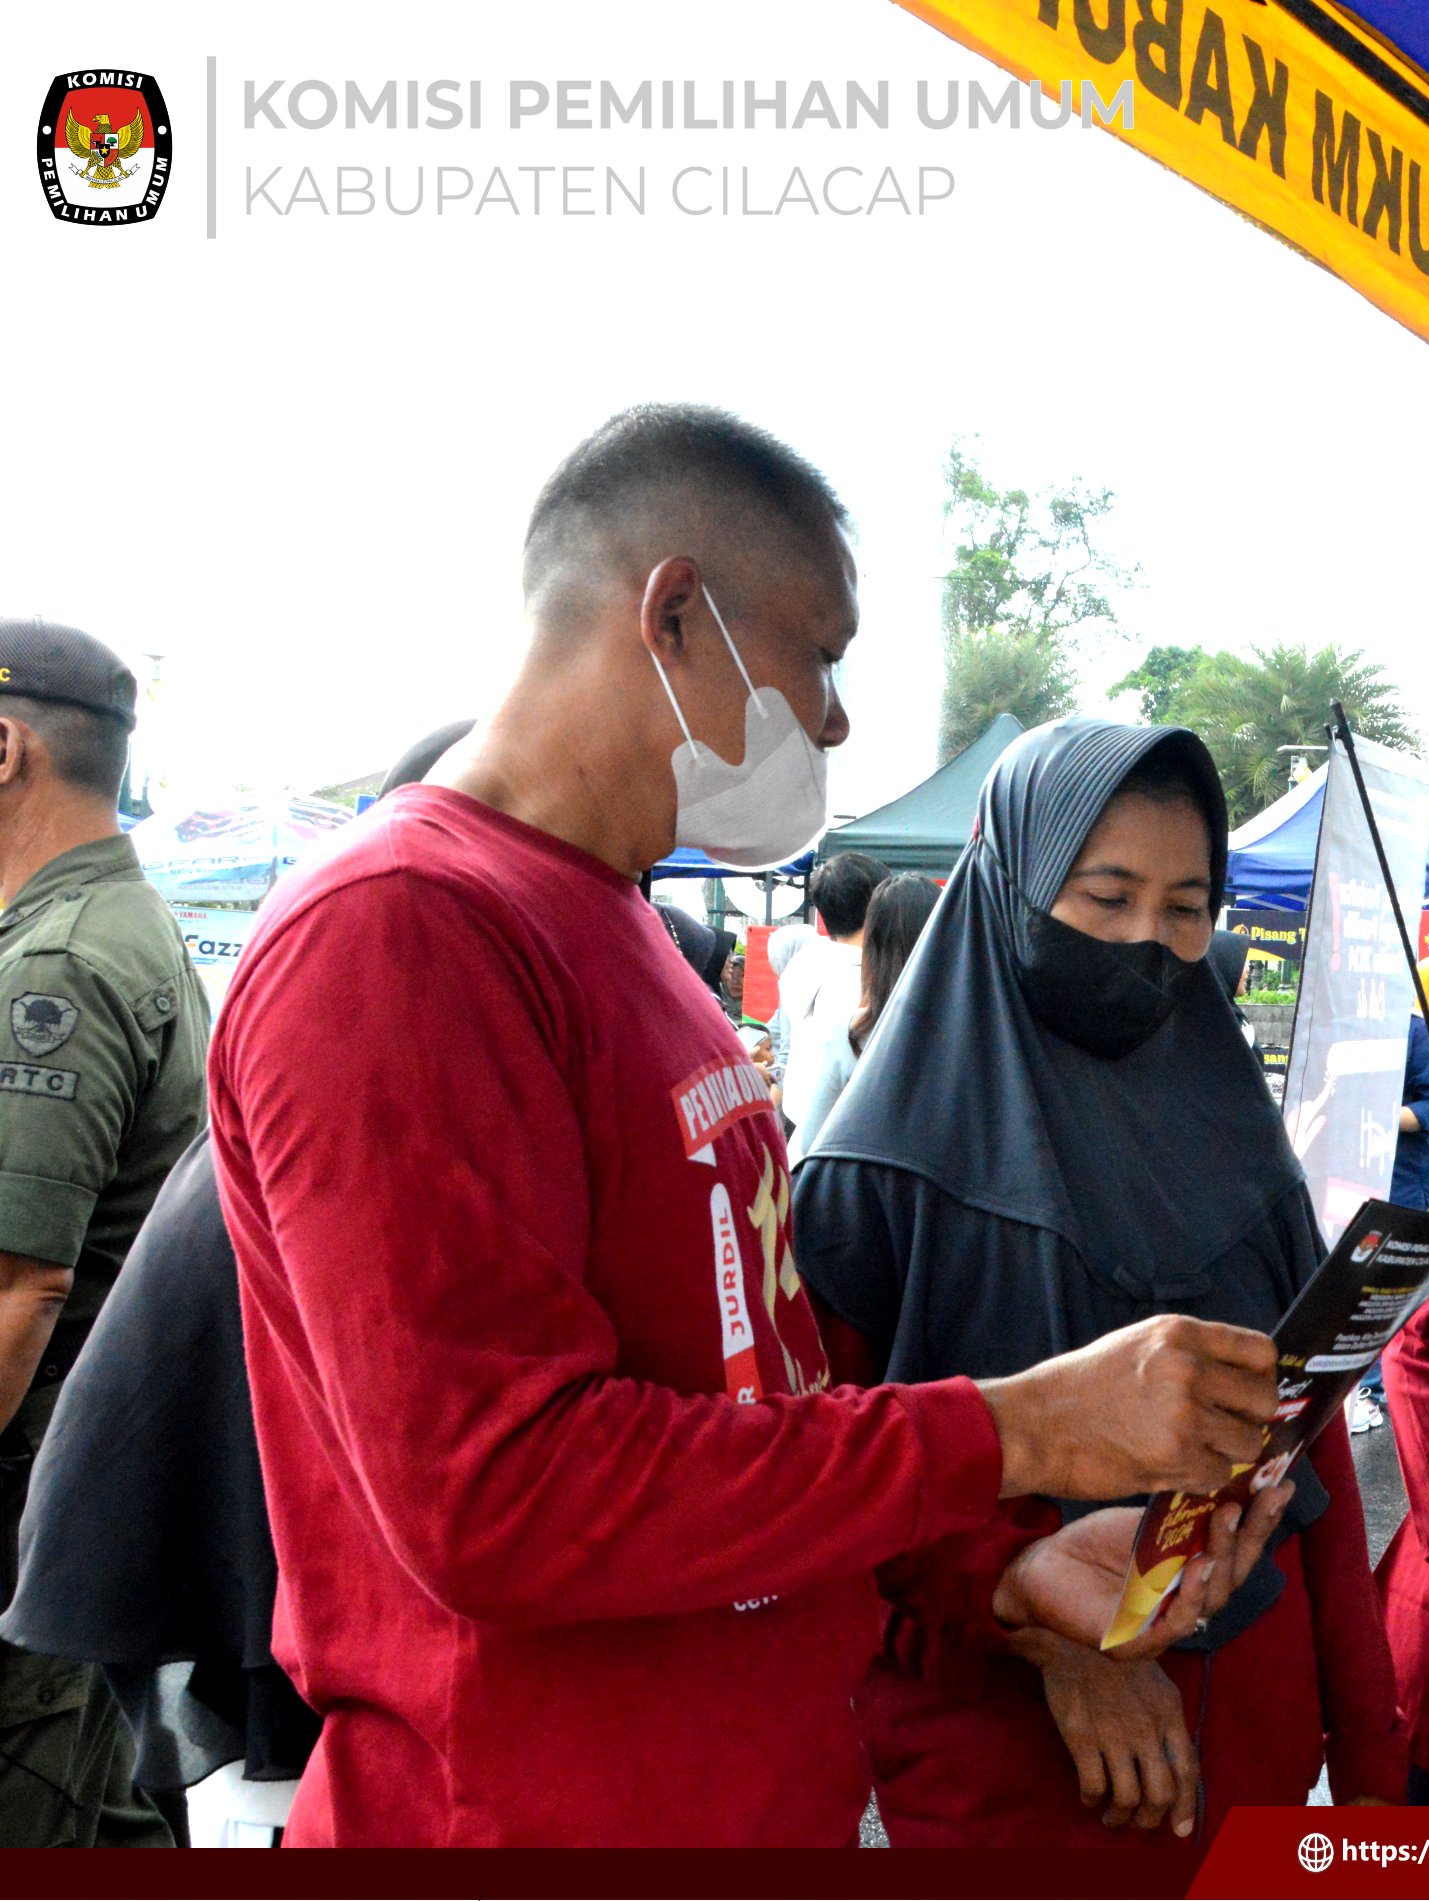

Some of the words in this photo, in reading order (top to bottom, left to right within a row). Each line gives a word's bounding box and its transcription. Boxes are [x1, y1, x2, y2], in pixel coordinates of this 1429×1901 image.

[179, 912, 207, 920] YAMAHA
[1250, 926, 1297, 945] Pisang
[719, 1207, 745, 1336] JURDIL
